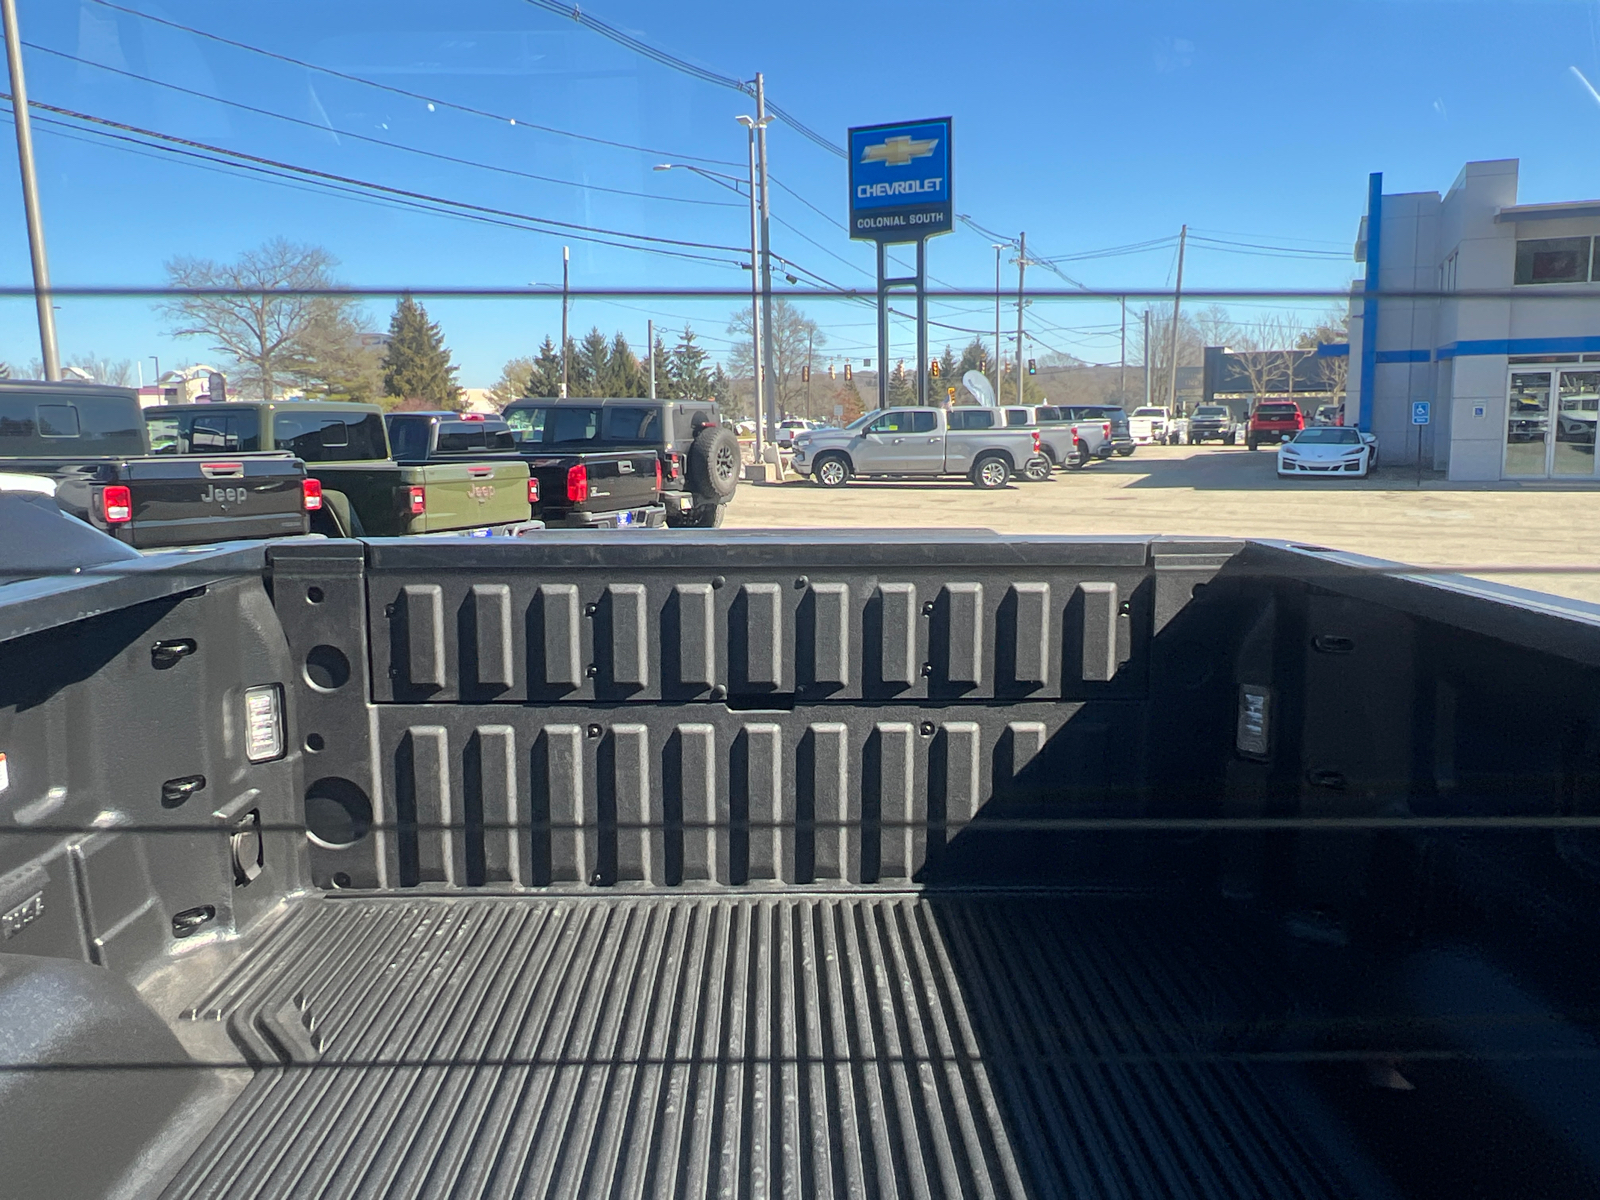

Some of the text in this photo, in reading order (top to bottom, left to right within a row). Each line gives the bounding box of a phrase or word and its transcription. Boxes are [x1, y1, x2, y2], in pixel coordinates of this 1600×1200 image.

[857, 178, 942, 198] CHEVROLET
[857, 212, 943, 228] COLONIAL SOUTH
[200, 484, 247, 504] Jeep
[466, 483, 496, 500] Jeep
